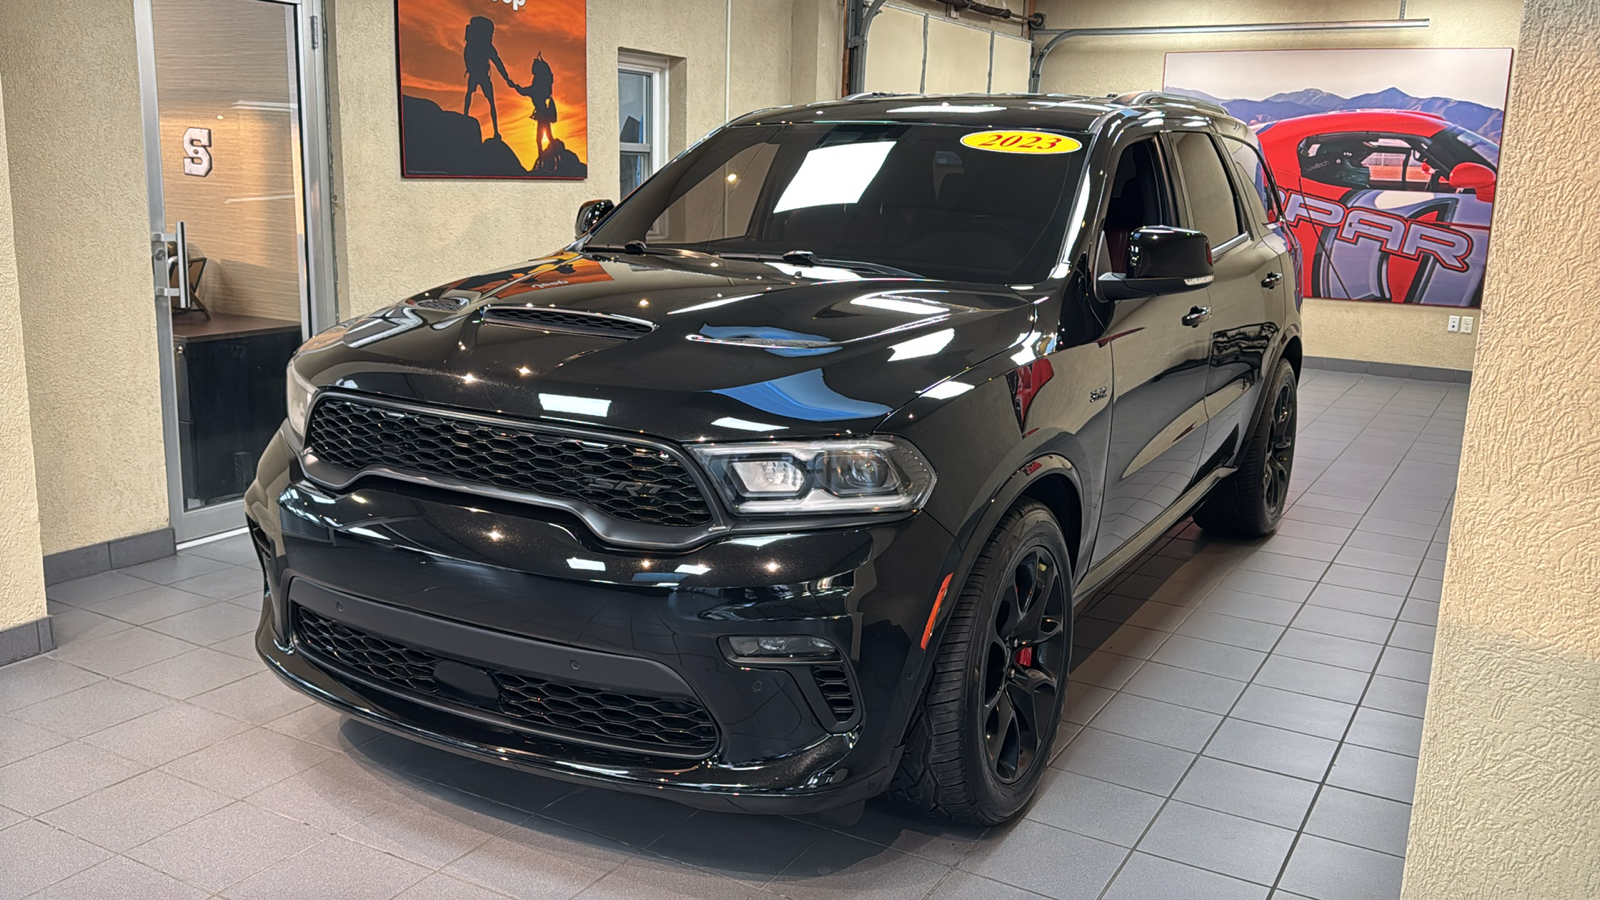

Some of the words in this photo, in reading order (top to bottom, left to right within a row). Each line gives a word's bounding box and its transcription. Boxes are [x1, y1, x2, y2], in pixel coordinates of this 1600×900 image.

[183, 127, 212, 177] S
[979, 134, 1062, 149] 2023
[1280, 191, 1471, 271] PAR
[588, 477, 672, 497] SRT
